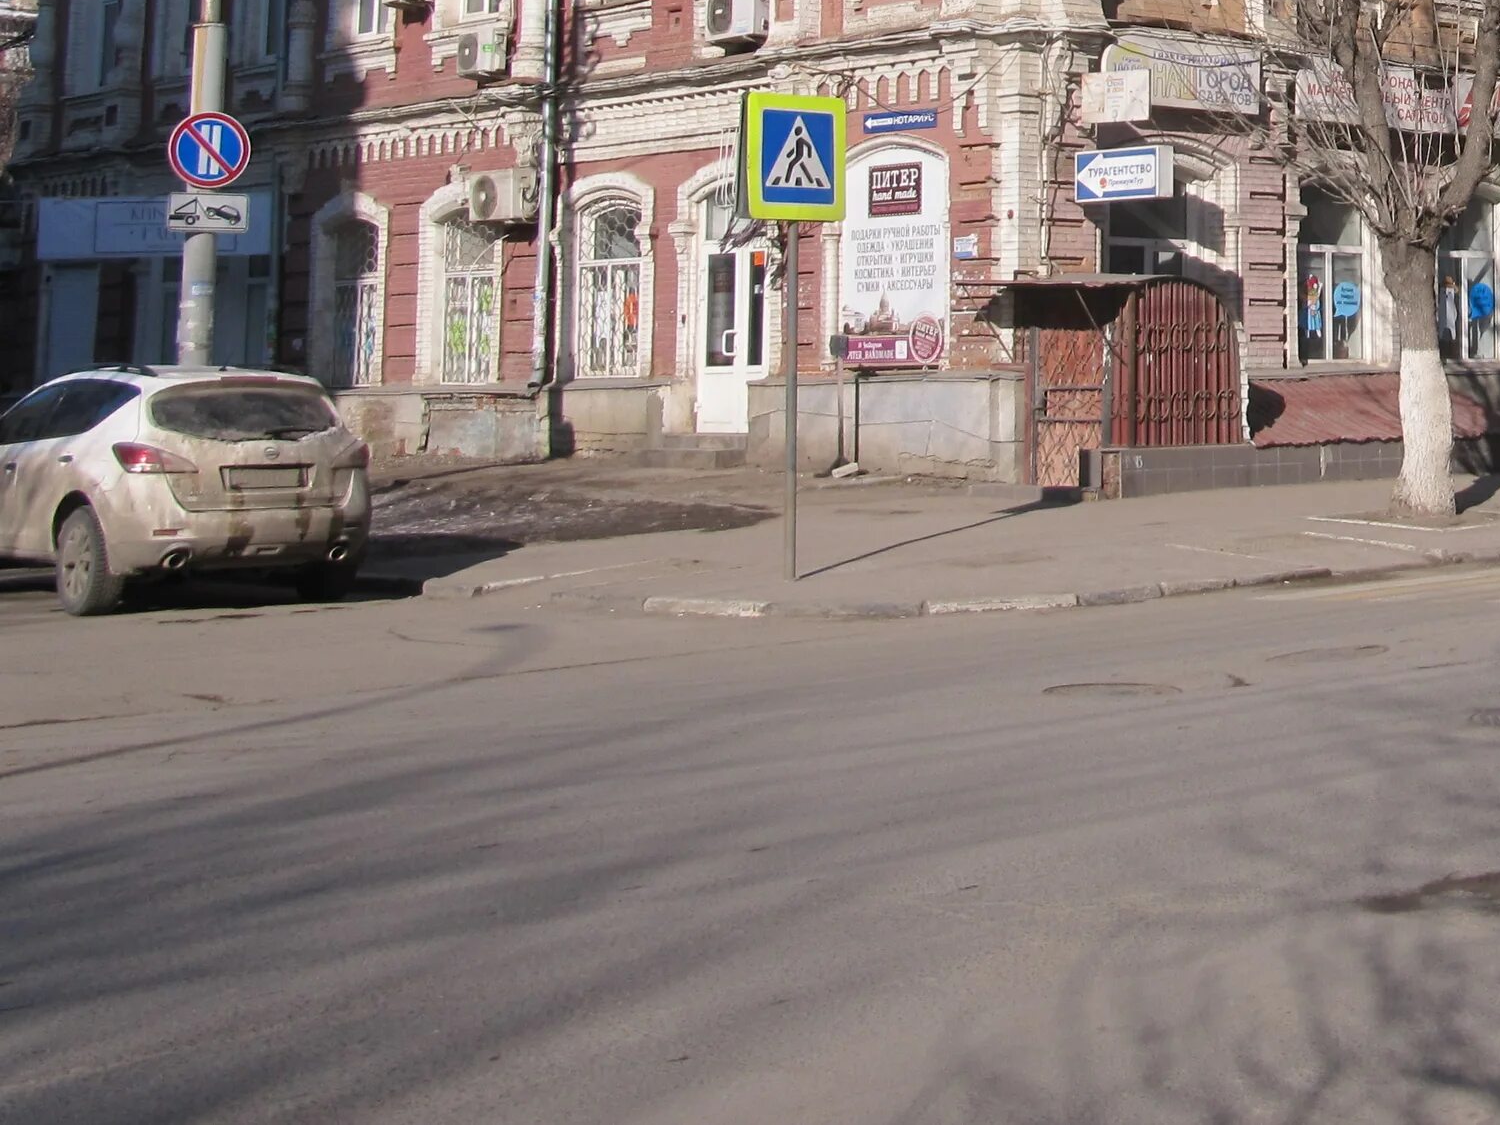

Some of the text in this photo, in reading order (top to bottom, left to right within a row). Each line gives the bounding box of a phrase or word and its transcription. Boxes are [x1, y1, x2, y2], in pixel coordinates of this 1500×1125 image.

[892, 113, 935, 125] НОТАРИУС
[1088, 163, 1152, 178] ТУРАГЕНТСТВО
[871, 168, 919, 189] ПИТЕР
[872, 187, 917, 201] hand made
[851, 224, 941, 241] ПОДАРКИ РУЧНОЙ РАБОТЫ
[856, 238, 934, 254] ОДЕЖДА УКРАШЕНИЯ
[856, 252, 934, 267] ОТКРЫТКИ ИГРУШКИ
[854, 264, 937, 280] КОСМЕТИКА ИНТЕРЬЕР
[856, 278, 934, 293] СУМКИ АКСЕССУАРЫ
